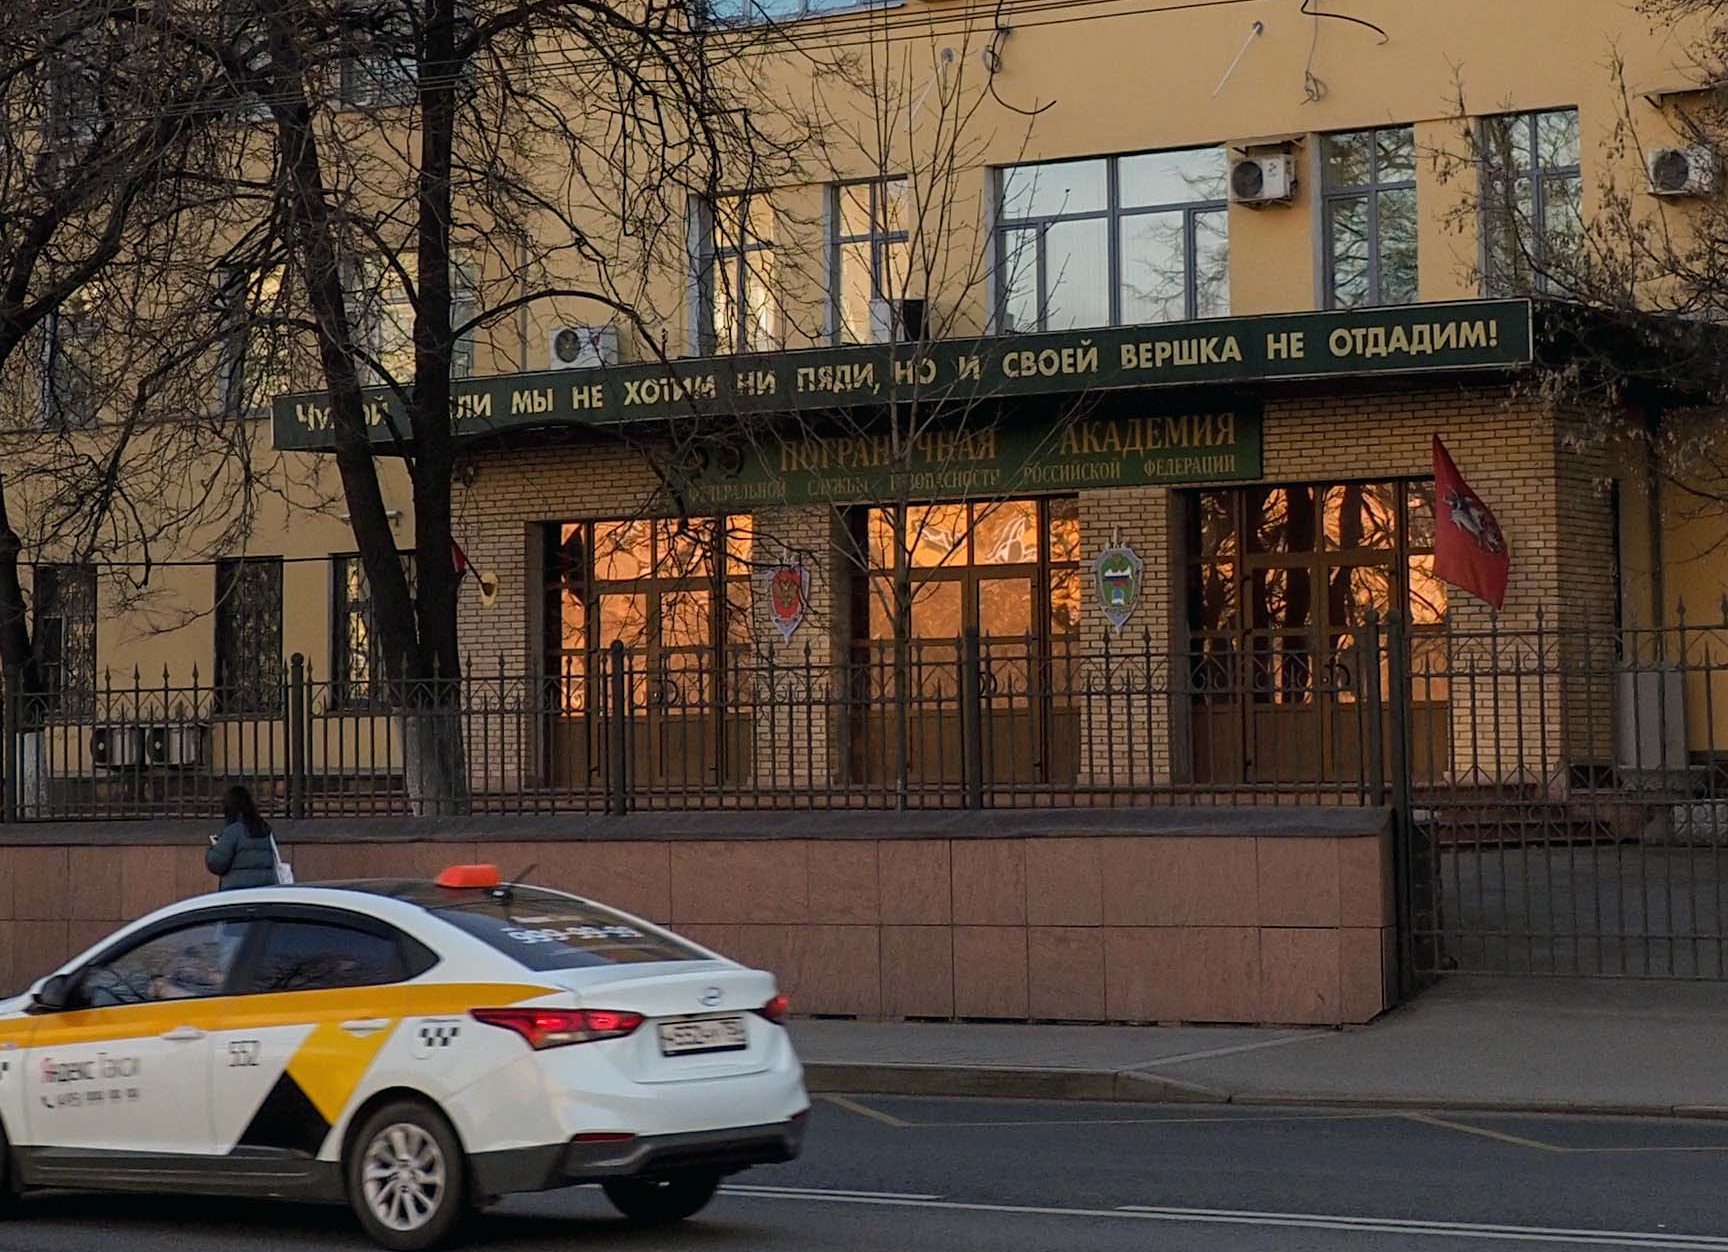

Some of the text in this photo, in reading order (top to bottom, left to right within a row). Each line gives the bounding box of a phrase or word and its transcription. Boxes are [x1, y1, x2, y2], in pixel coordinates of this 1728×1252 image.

[511, 388, 554, 415] МЫ
[572, 384, 604, 410] НЕ
[736, 369, 777, 397] НИ
[797, 362, 881, 396] ПЯДИ,
[895, 357, 938, 386] НО
[958, 354, 981, 381] И
[1001, 339, 1099, 379] СВОЕЙ
[1120, 336, 1243, 371] ВЕРШКА
[1266, 331, 1305, 361] НЕ
[1328, 319, 1499, 359] ОТДАДИМ!
[779, 411, 1237, 473] ПОГРАНЧНАЯ АКАДЕМИЯ
[1023, 459, 1121, 484] РОССИЙСКОЙ
[1143, 453, 1237, 477] ФЕДЕРАЦИИ
[228, 1039, 262, 1068] 552
